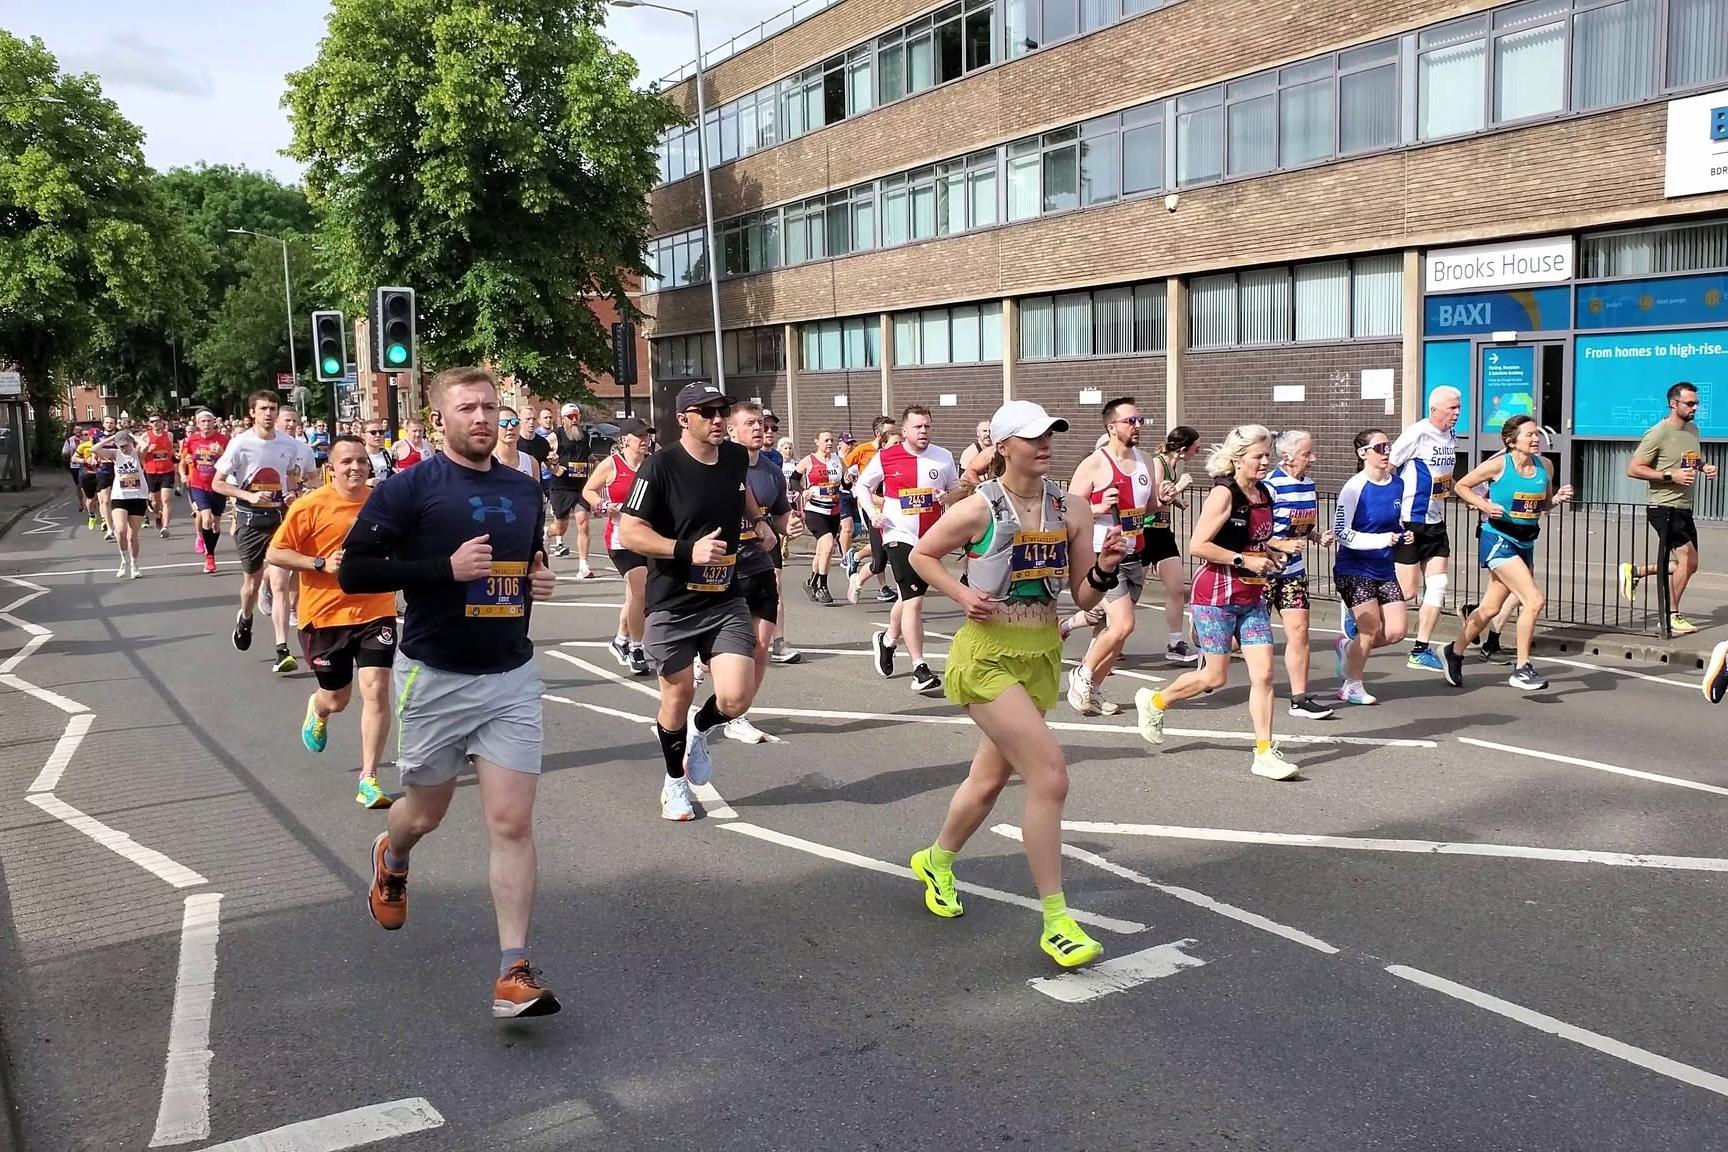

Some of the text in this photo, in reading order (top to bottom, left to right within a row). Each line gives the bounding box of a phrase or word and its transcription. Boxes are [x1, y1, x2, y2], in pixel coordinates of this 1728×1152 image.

[1434, 253, 1565, 281] Brooks House
[1439, 303, 1492, 327] BAXI
[1585, 348, 1613, 358] From
[1615, 346, 1652, 358] homes
[1655, 345, 1667, 357] to
[908, 495, 926, 505] 2443
[1023, 543, 1057, 562] 4114
[702, 566, 728, 579] 4373
[486, 577, 519, 596] 3106
